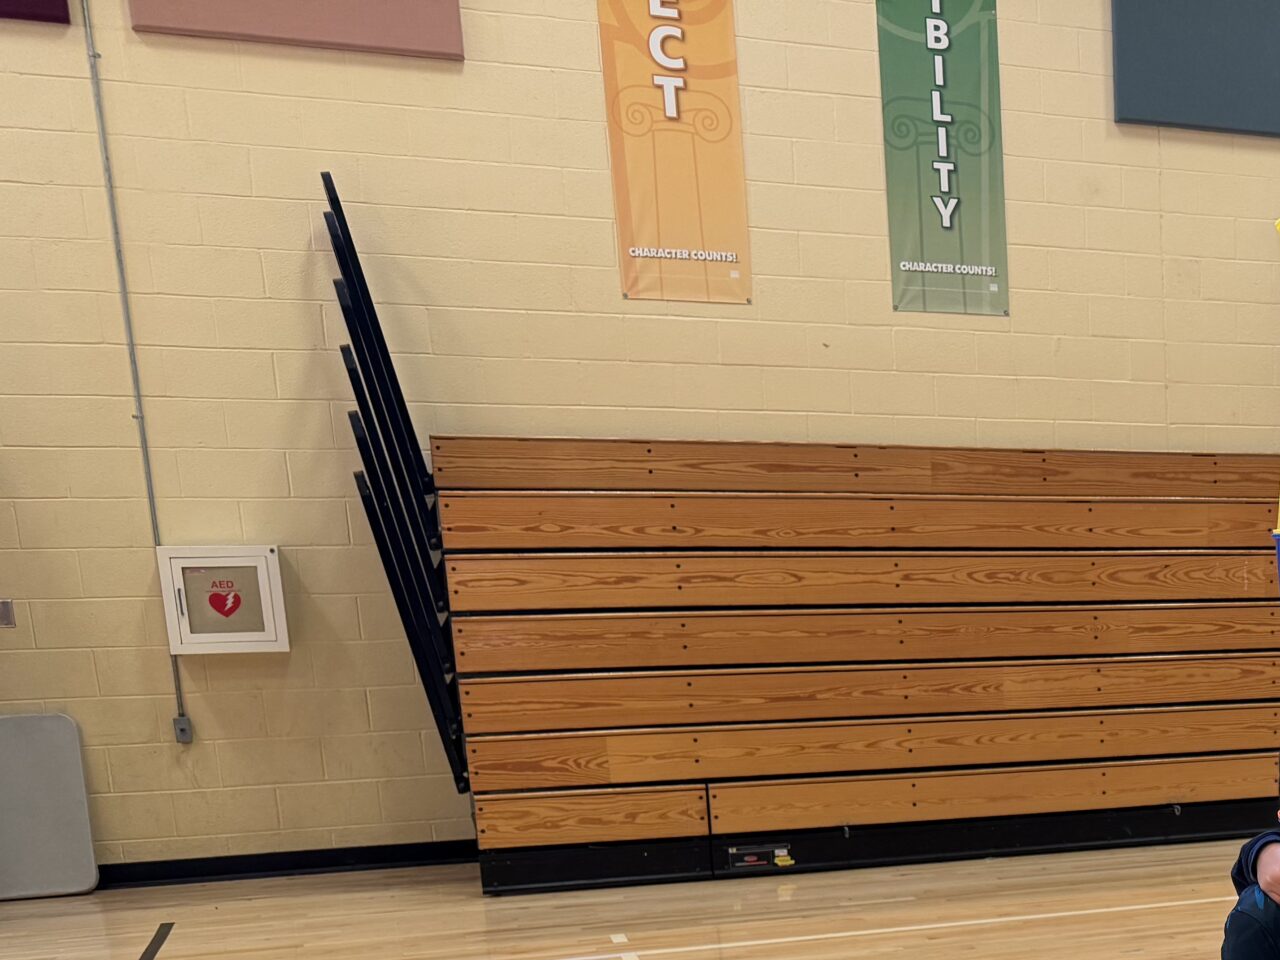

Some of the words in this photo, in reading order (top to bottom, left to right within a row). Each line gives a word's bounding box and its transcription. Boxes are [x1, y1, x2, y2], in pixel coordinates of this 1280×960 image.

[628, 247, 690, 260] CHARACTER
[690, 249, 738, 264] COUNTS!
[899, 260, 955, 273] CHARACTER
[954, 263, 998, 278] COUNTS!
[210, 580, 235, 590] AED
